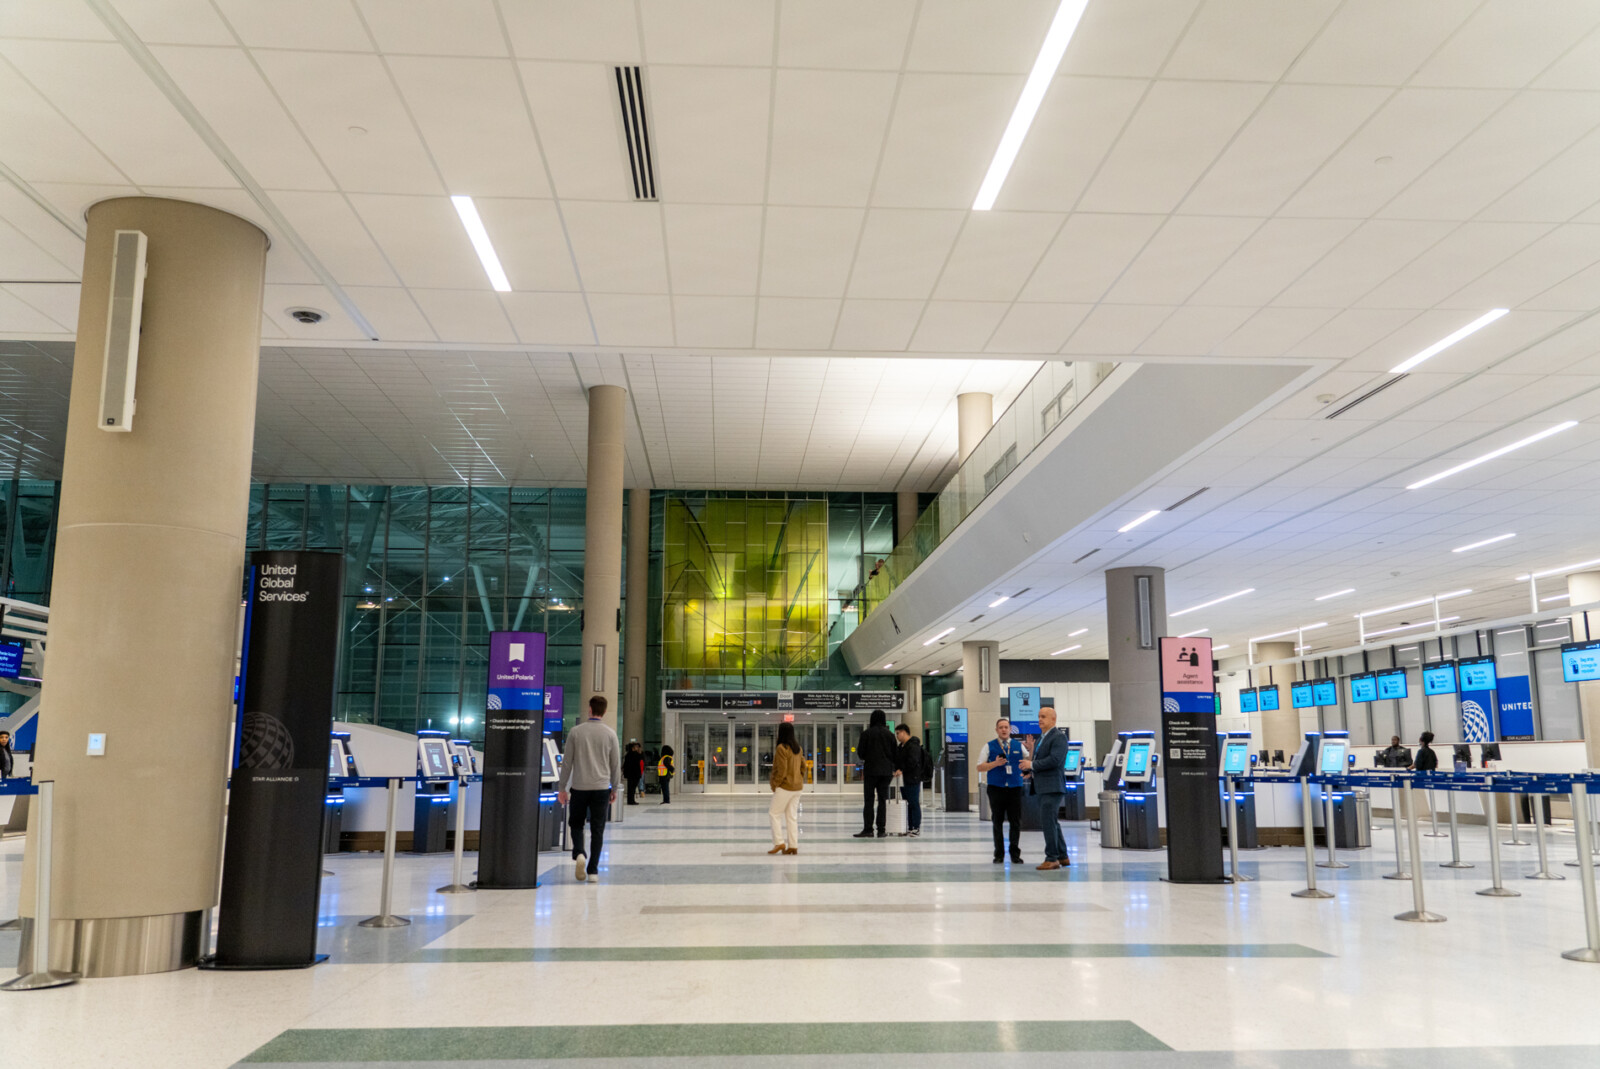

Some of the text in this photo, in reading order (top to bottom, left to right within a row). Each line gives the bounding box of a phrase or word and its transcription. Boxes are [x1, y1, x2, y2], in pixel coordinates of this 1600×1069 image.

[261, 564, 297, 575] United
[260, 577, 294, 589] Global
[1501, 702, 1533, 711] UNITED
